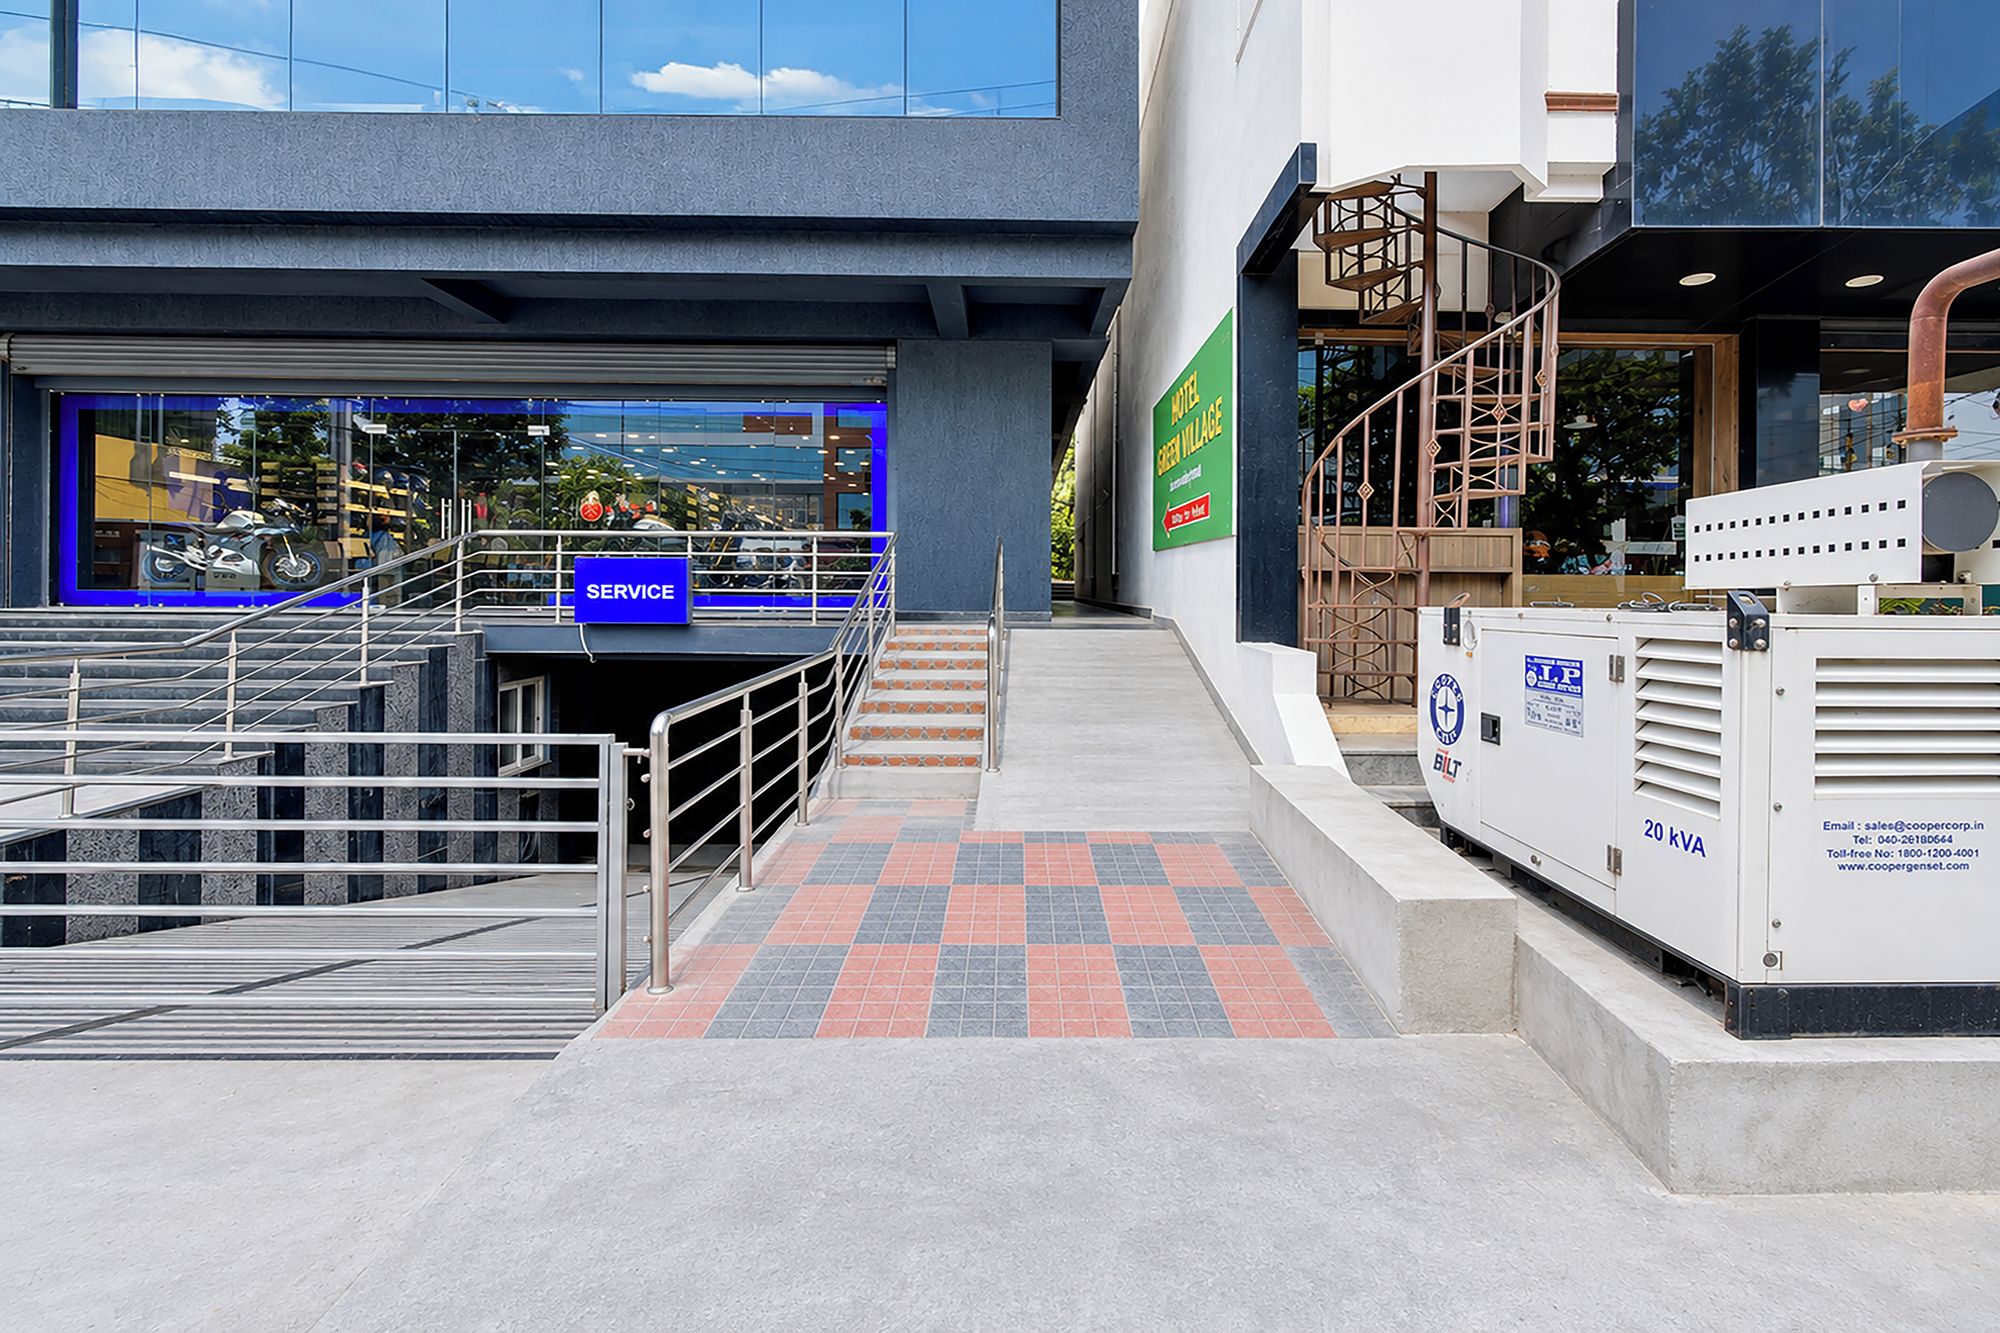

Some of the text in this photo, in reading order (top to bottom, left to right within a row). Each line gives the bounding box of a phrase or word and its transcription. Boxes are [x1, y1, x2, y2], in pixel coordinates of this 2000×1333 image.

[1171, 370, 1200, 426] HOTEL
[1157, 395, 1223, 477] GREEN VILLAGE
[586, 584, 675, 599] SERVICE
[1823, 821, 1855, 831] Email
[1864, 820, 1984, 833] sales@coopercorp.in
[1644, 818, 1707, 858] 20 kVA
[1853, 834, 1872, 845] Tel:
[1826, 848, 1979, 858] Toll-free No: 1800-1200-4001
[1837, 861, 1970, 873] www.coopergenset.com
